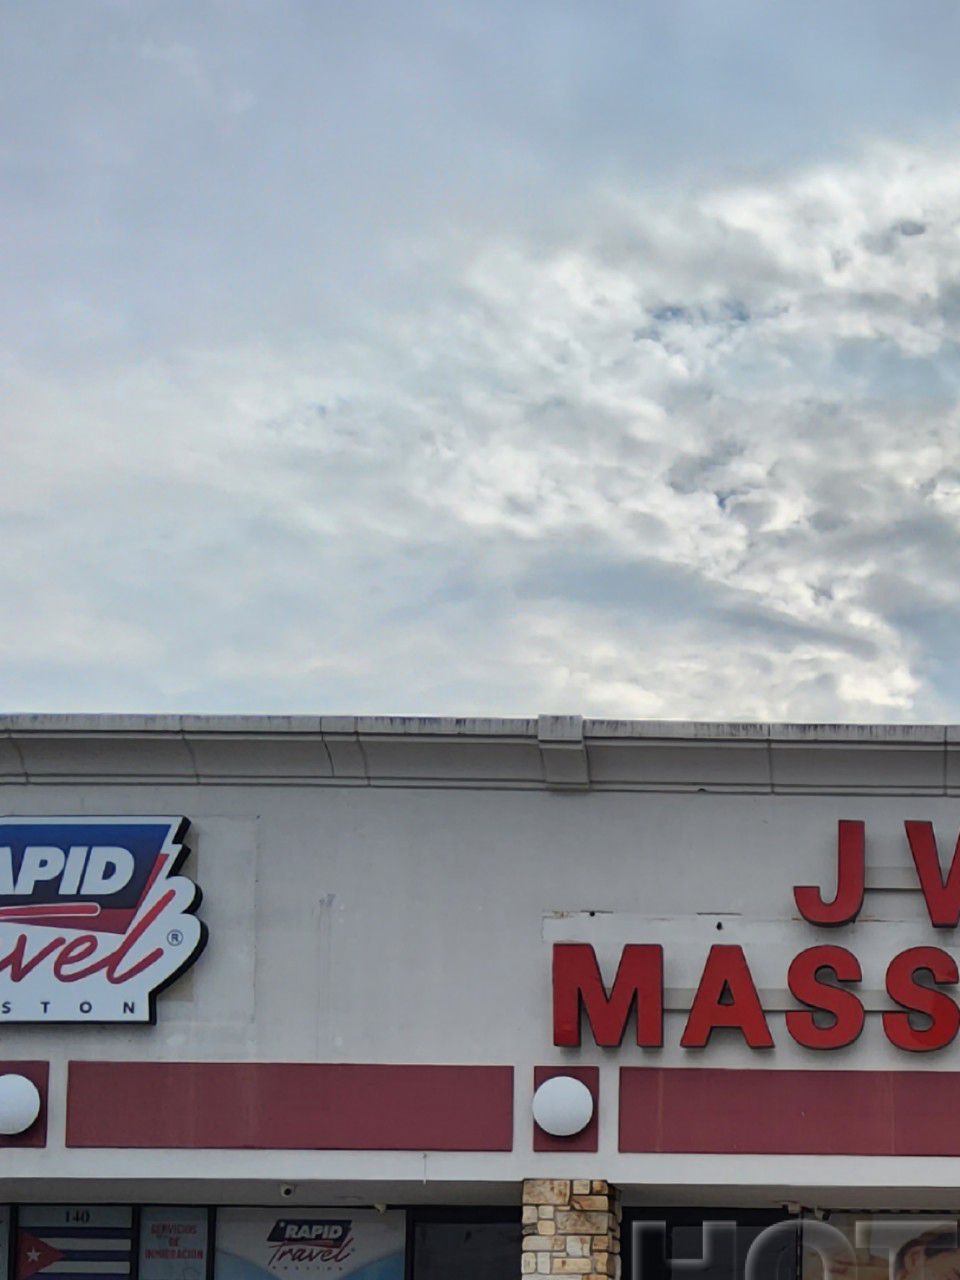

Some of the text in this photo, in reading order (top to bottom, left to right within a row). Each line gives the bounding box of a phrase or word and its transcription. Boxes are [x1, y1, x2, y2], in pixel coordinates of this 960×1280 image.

[65, 1209, 91, 1223] 140
[285, 1224, 343, 1239] RAPID
[267, 1238, 354, 1266] Travel
